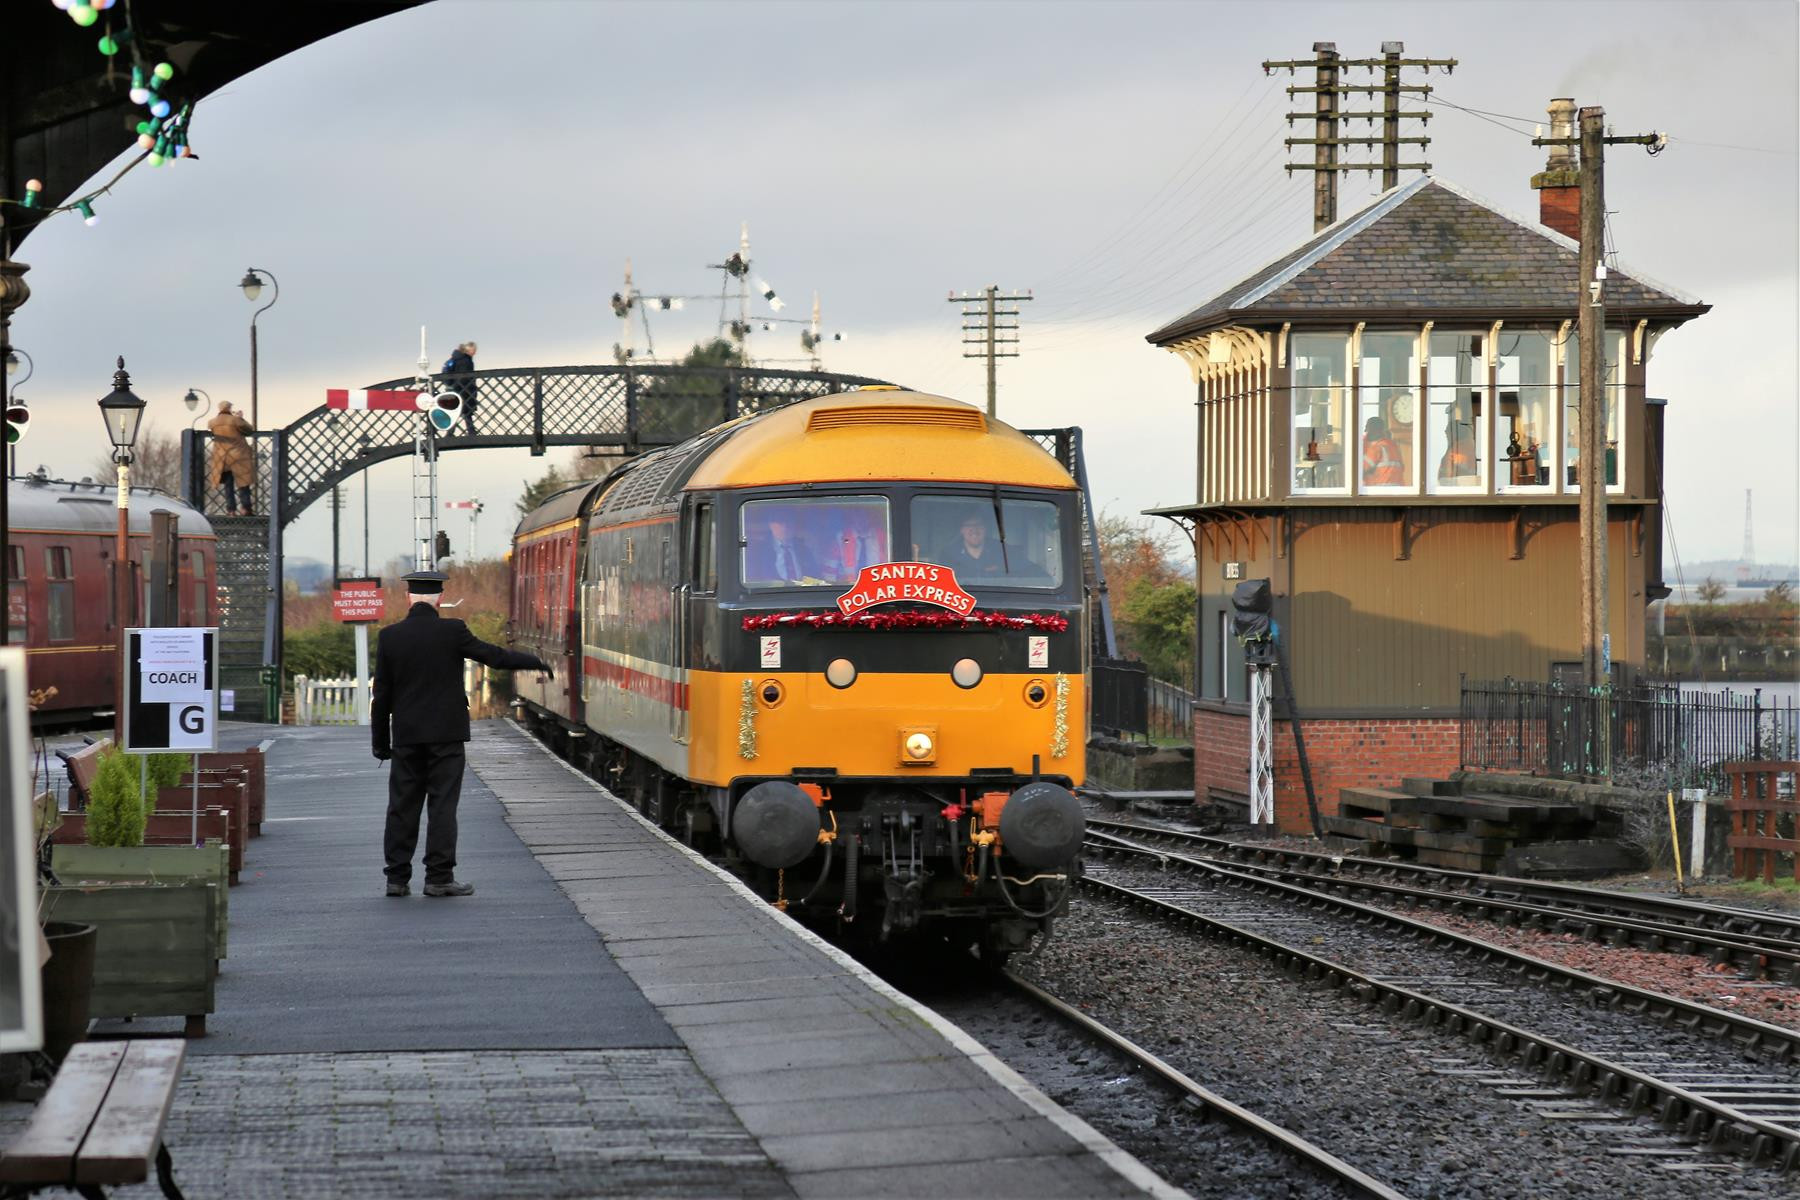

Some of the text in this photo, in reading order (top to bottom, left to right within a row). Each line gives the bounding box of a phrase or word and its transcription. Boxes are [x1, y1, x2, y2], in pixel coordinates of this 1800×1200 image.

[871, 566, 938, 581] SANTA'S
[842, 584, 970, 612] POLAR EXPRESS
[341, 608, 356, 616] THIS
[149, 672, 197, 684] COACH
[179, 705, 204, 734] G
